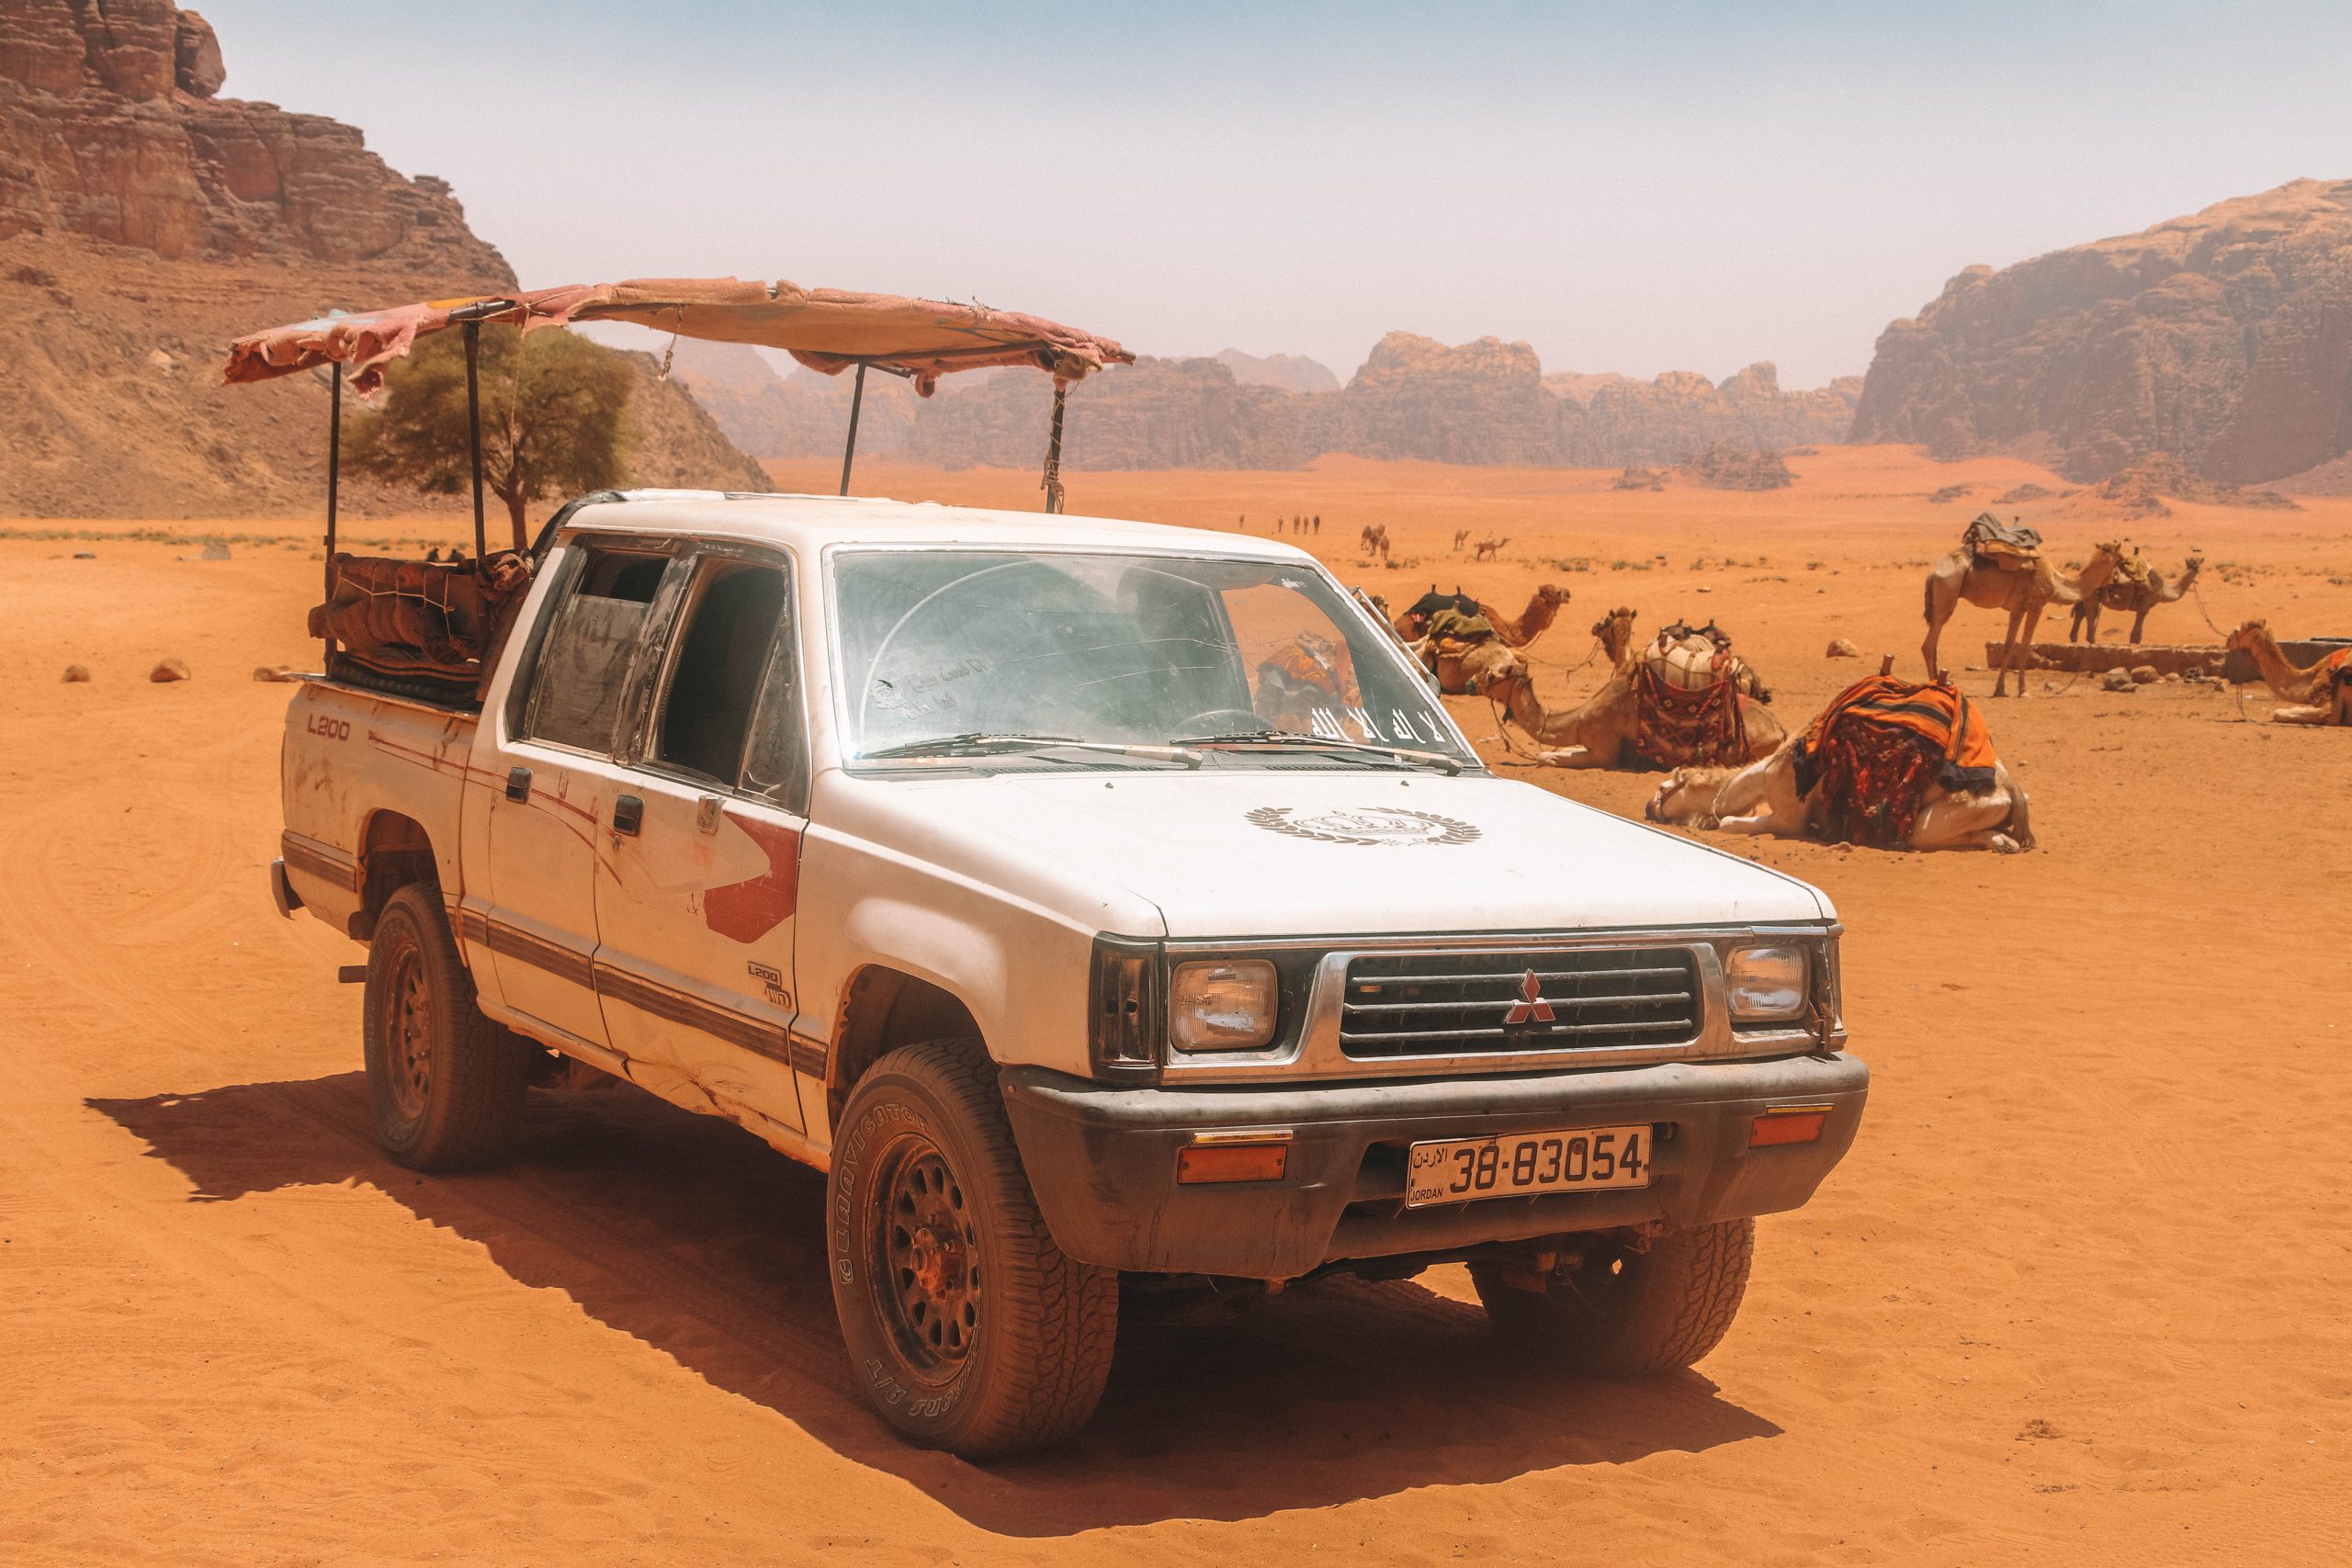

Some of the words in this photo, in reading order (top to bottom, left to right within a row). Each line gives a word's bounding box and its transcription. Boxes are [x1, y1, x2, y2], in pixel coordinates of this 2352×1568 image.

[306, 714, 351, 741] L200
[1310, 706, 1355, 743] الله
[1417, 710, 1446, 743] لا
[747, 964, 779, 983] L200
[1412, 1146, 1448, 1169] الاردن
[1449, 1134, 1642, 1193] 38-83054
[1409, 1187, 1444, 1201] JORDAN
